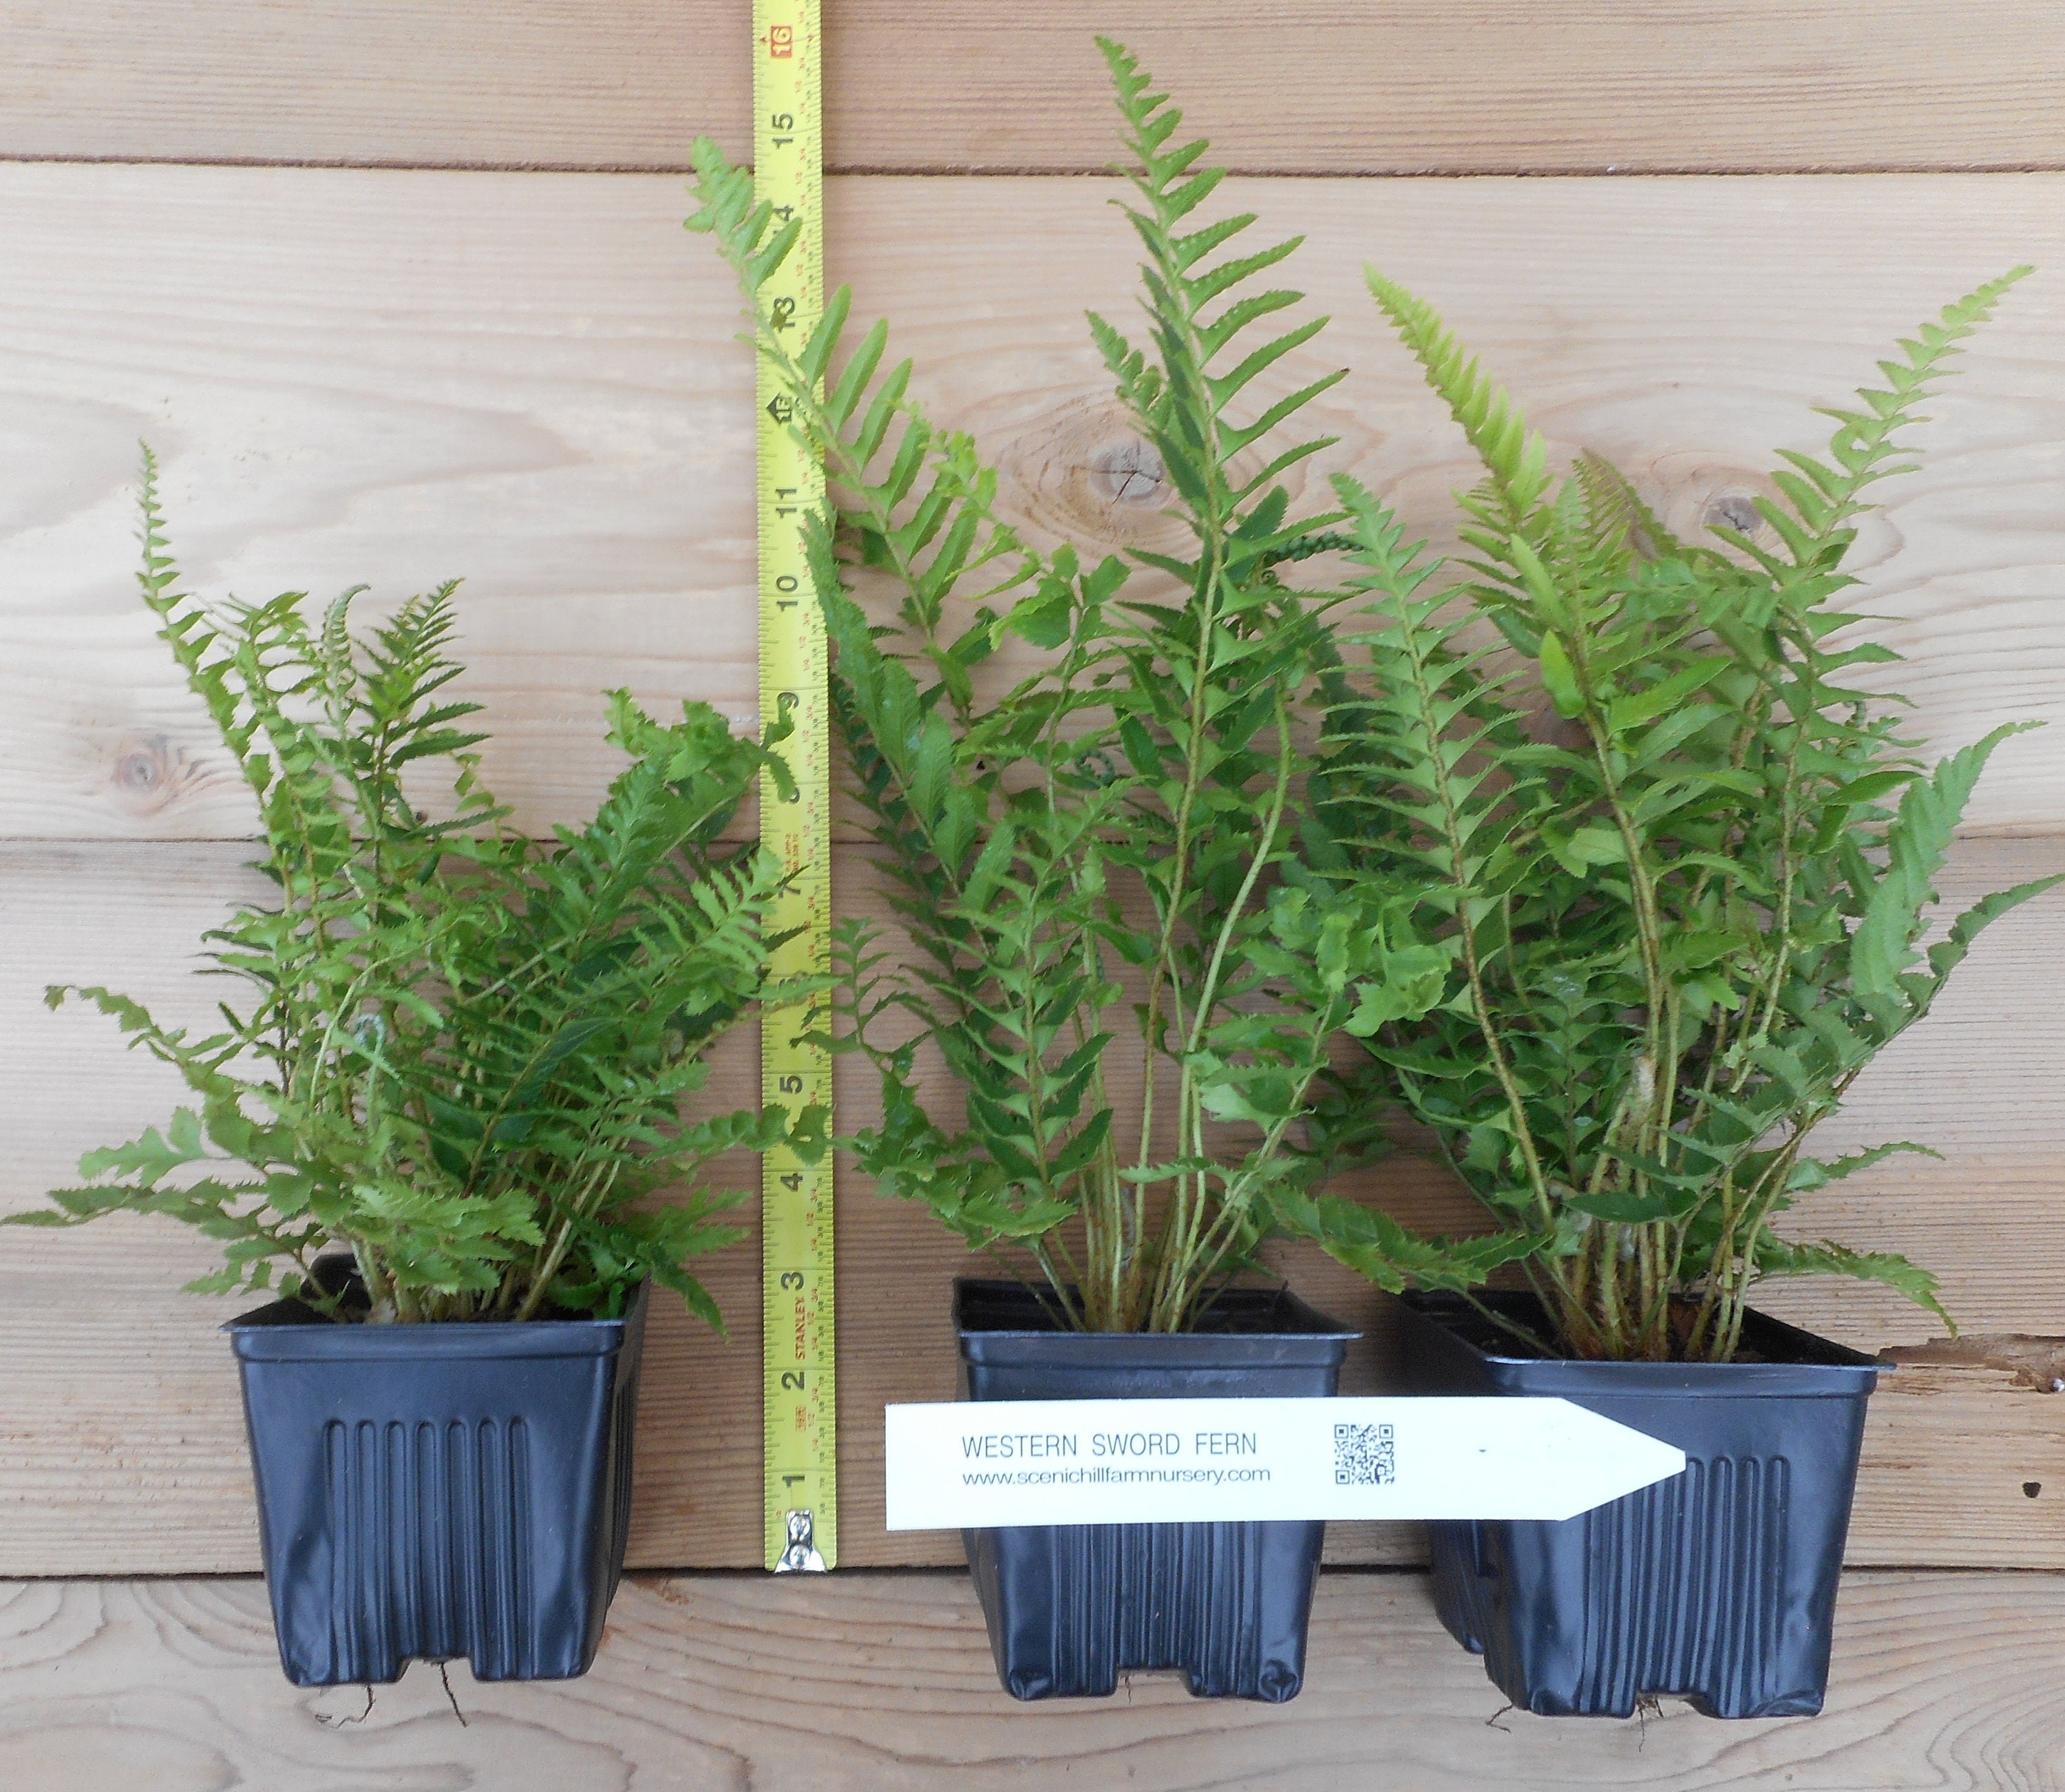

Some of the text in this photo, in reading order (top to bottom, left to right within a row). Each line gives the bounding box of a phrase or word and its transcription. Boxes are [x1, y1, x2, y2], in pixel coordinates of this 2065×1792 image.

[771, 25, 792, 56] 16
[772, 113, 794, 149] 15
[775, 488, 796, 518] 11
[776, 575, 798, 611] 10
[779, 1075, 803, 1093] 5
[780, 1172, 803, 1191] 4
[781, 1271, 804, 1289] 3
[795, 1296, 805, 1360] STANLEY
[781, 1371, 805, 1389] 2
[962, 1432, 1257, 1459] WESTERN SWORD FERN
[782, 1475, 805, 1486] 1
[962, 1467, 1271, 1486] www.scenichillfarmnursery.com
